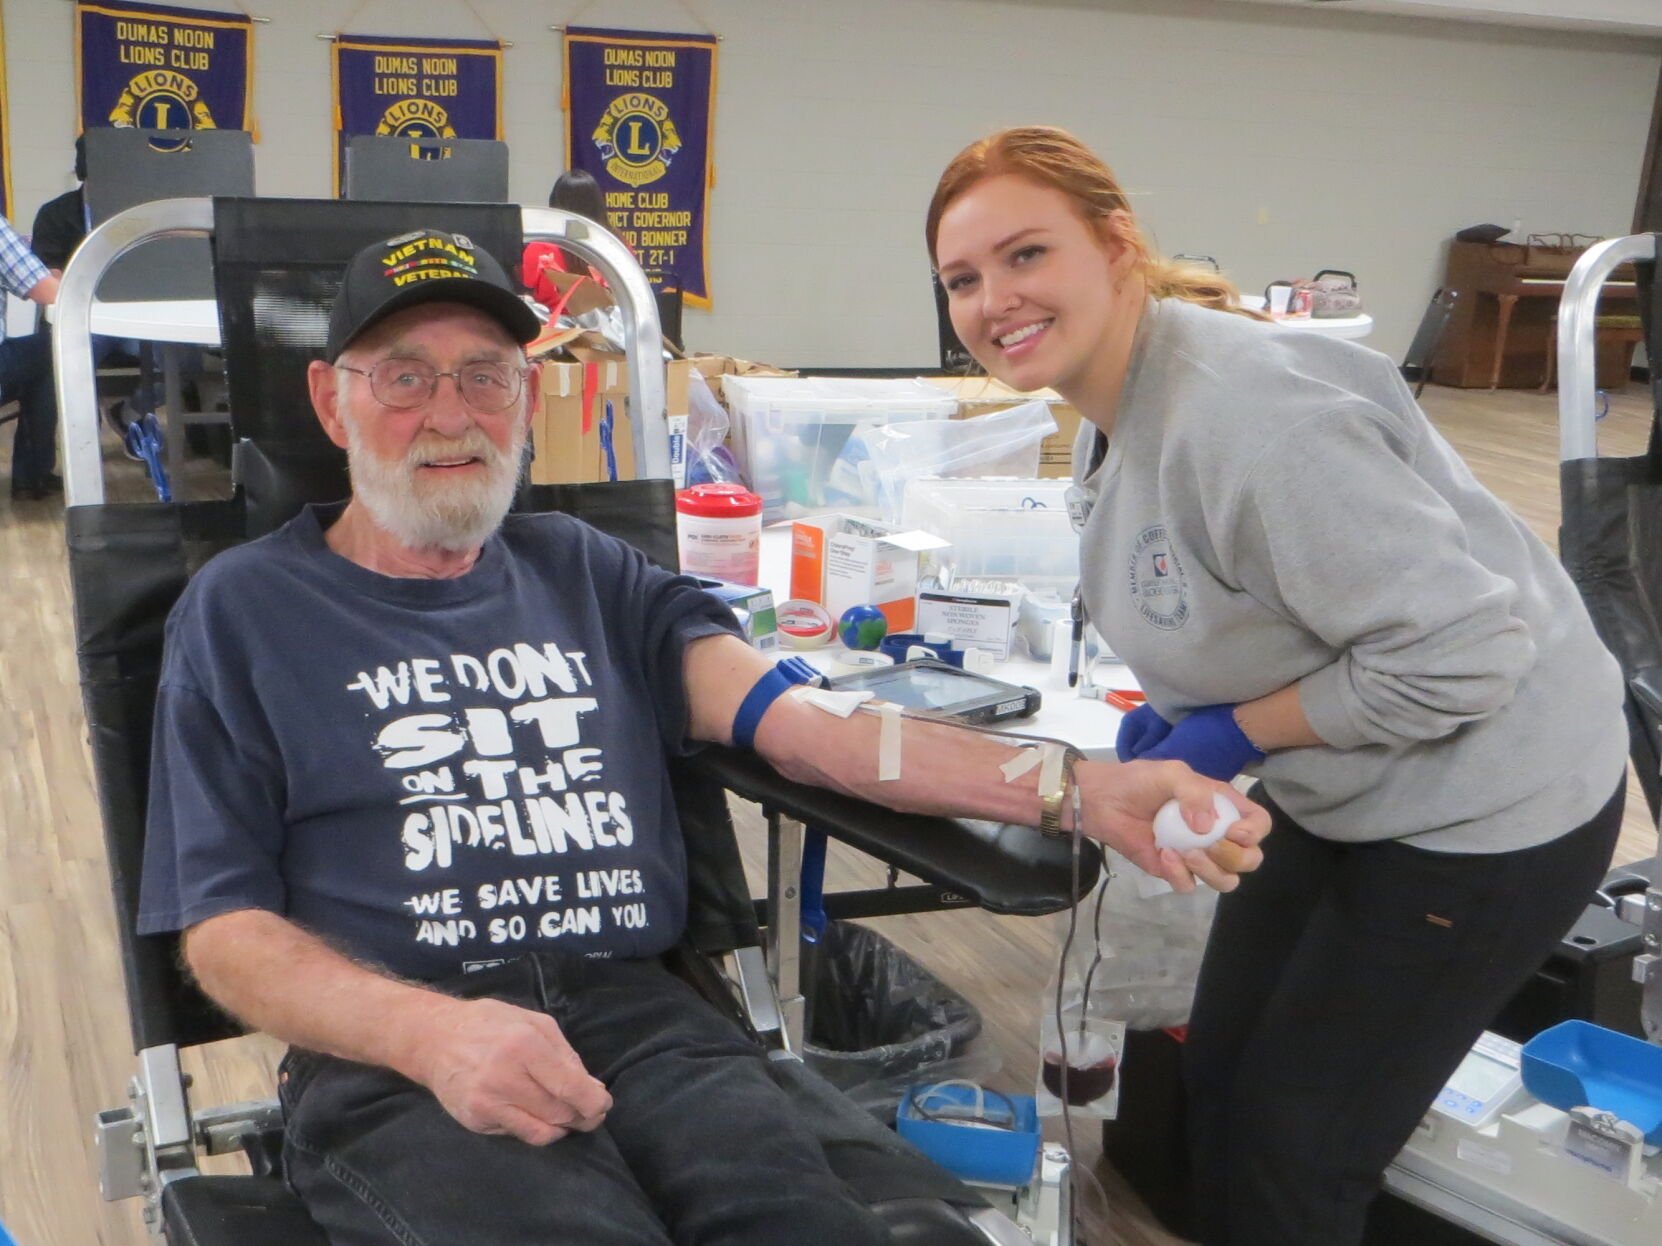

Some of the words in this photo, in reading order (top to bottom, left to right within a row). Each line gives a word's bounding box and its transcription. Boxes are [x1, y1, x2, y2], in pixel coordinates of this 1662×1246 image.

[116, 21, 169, 45] DUMAS
[173, 28, 214, 49] NOON
[120, 45, 165, 66] LIONS
[171, 49, 209, 70] CLUB
[374, 56, 418, 74] DUMAS
[422, 58, 457, 75] NOON
[604, 48, 643, 66] DUMAS
[645, 51, 675, 67] NOON
[134, 71, 194, 97] LIONS
[374, 77, 417, 95] LIONS
[422, 79, 458, 96] CLUB
[606, 69, 640, 86] LIONS
[642, 71, 673, 88] CLUB
[389, 101, 443, 123] LIONS
[613, 95, 665, 118] LIONS
[627, 121, 650, 155] L
[605, 192, 635, 208] HOME
[638, 192, 669, 209] CLUB
[633, 211, 691, 227] GOVERNOR
[641, 230, 687, 247] BONNER
[382, 238, 475, 266] VIETNAM
[649, 249, 674, 265] 2T-1
[347, 658, 451, 710] WE
[371, 697, 599, 769] SIT
[401, 766, 455, 794] ON
[463, 748, 603, 800] THE
[401, 791, 634, 872] SIDELINES
[404, 889, 462, 915] WE
[477, 876, 563, 910] SAVE
[415, 919, 477, 946] AND
[488, 915, 527, 944] SO
[537, 906, 601, 938] CAN
